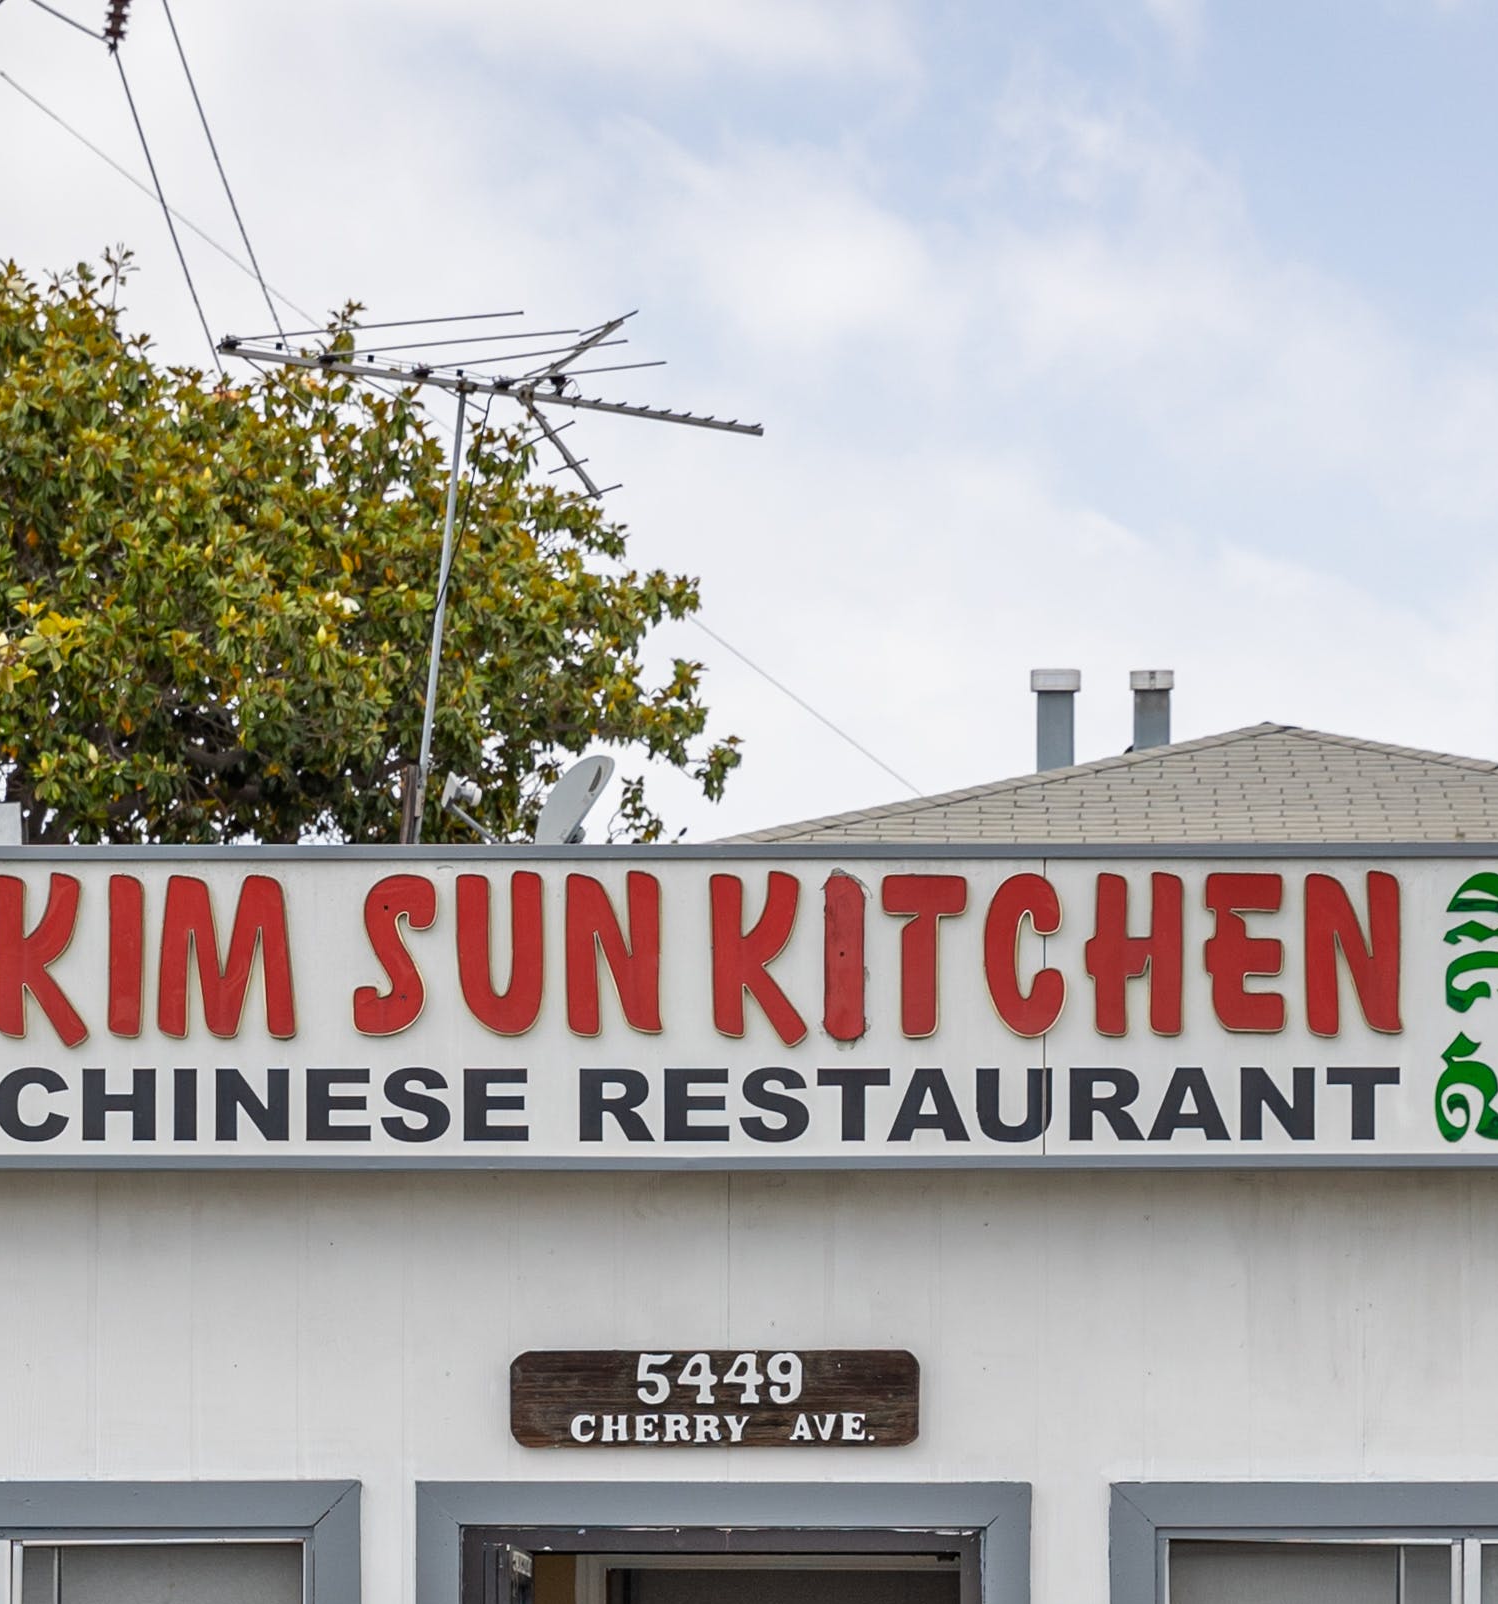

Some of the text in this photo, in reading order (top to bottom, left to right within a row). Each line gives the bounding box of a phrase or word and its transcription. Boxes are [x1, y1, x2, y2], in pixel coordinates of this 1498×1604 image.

[352, 870, 664, 1038] SUN
[709, 868, 1404, 1048] KITCHEN
[580, 1066, 1401, 1143] RESTAURANT
[636, 1352, 803, 1405] 5449
[570, 1412, 876, 1443] CHERRY AVE.
